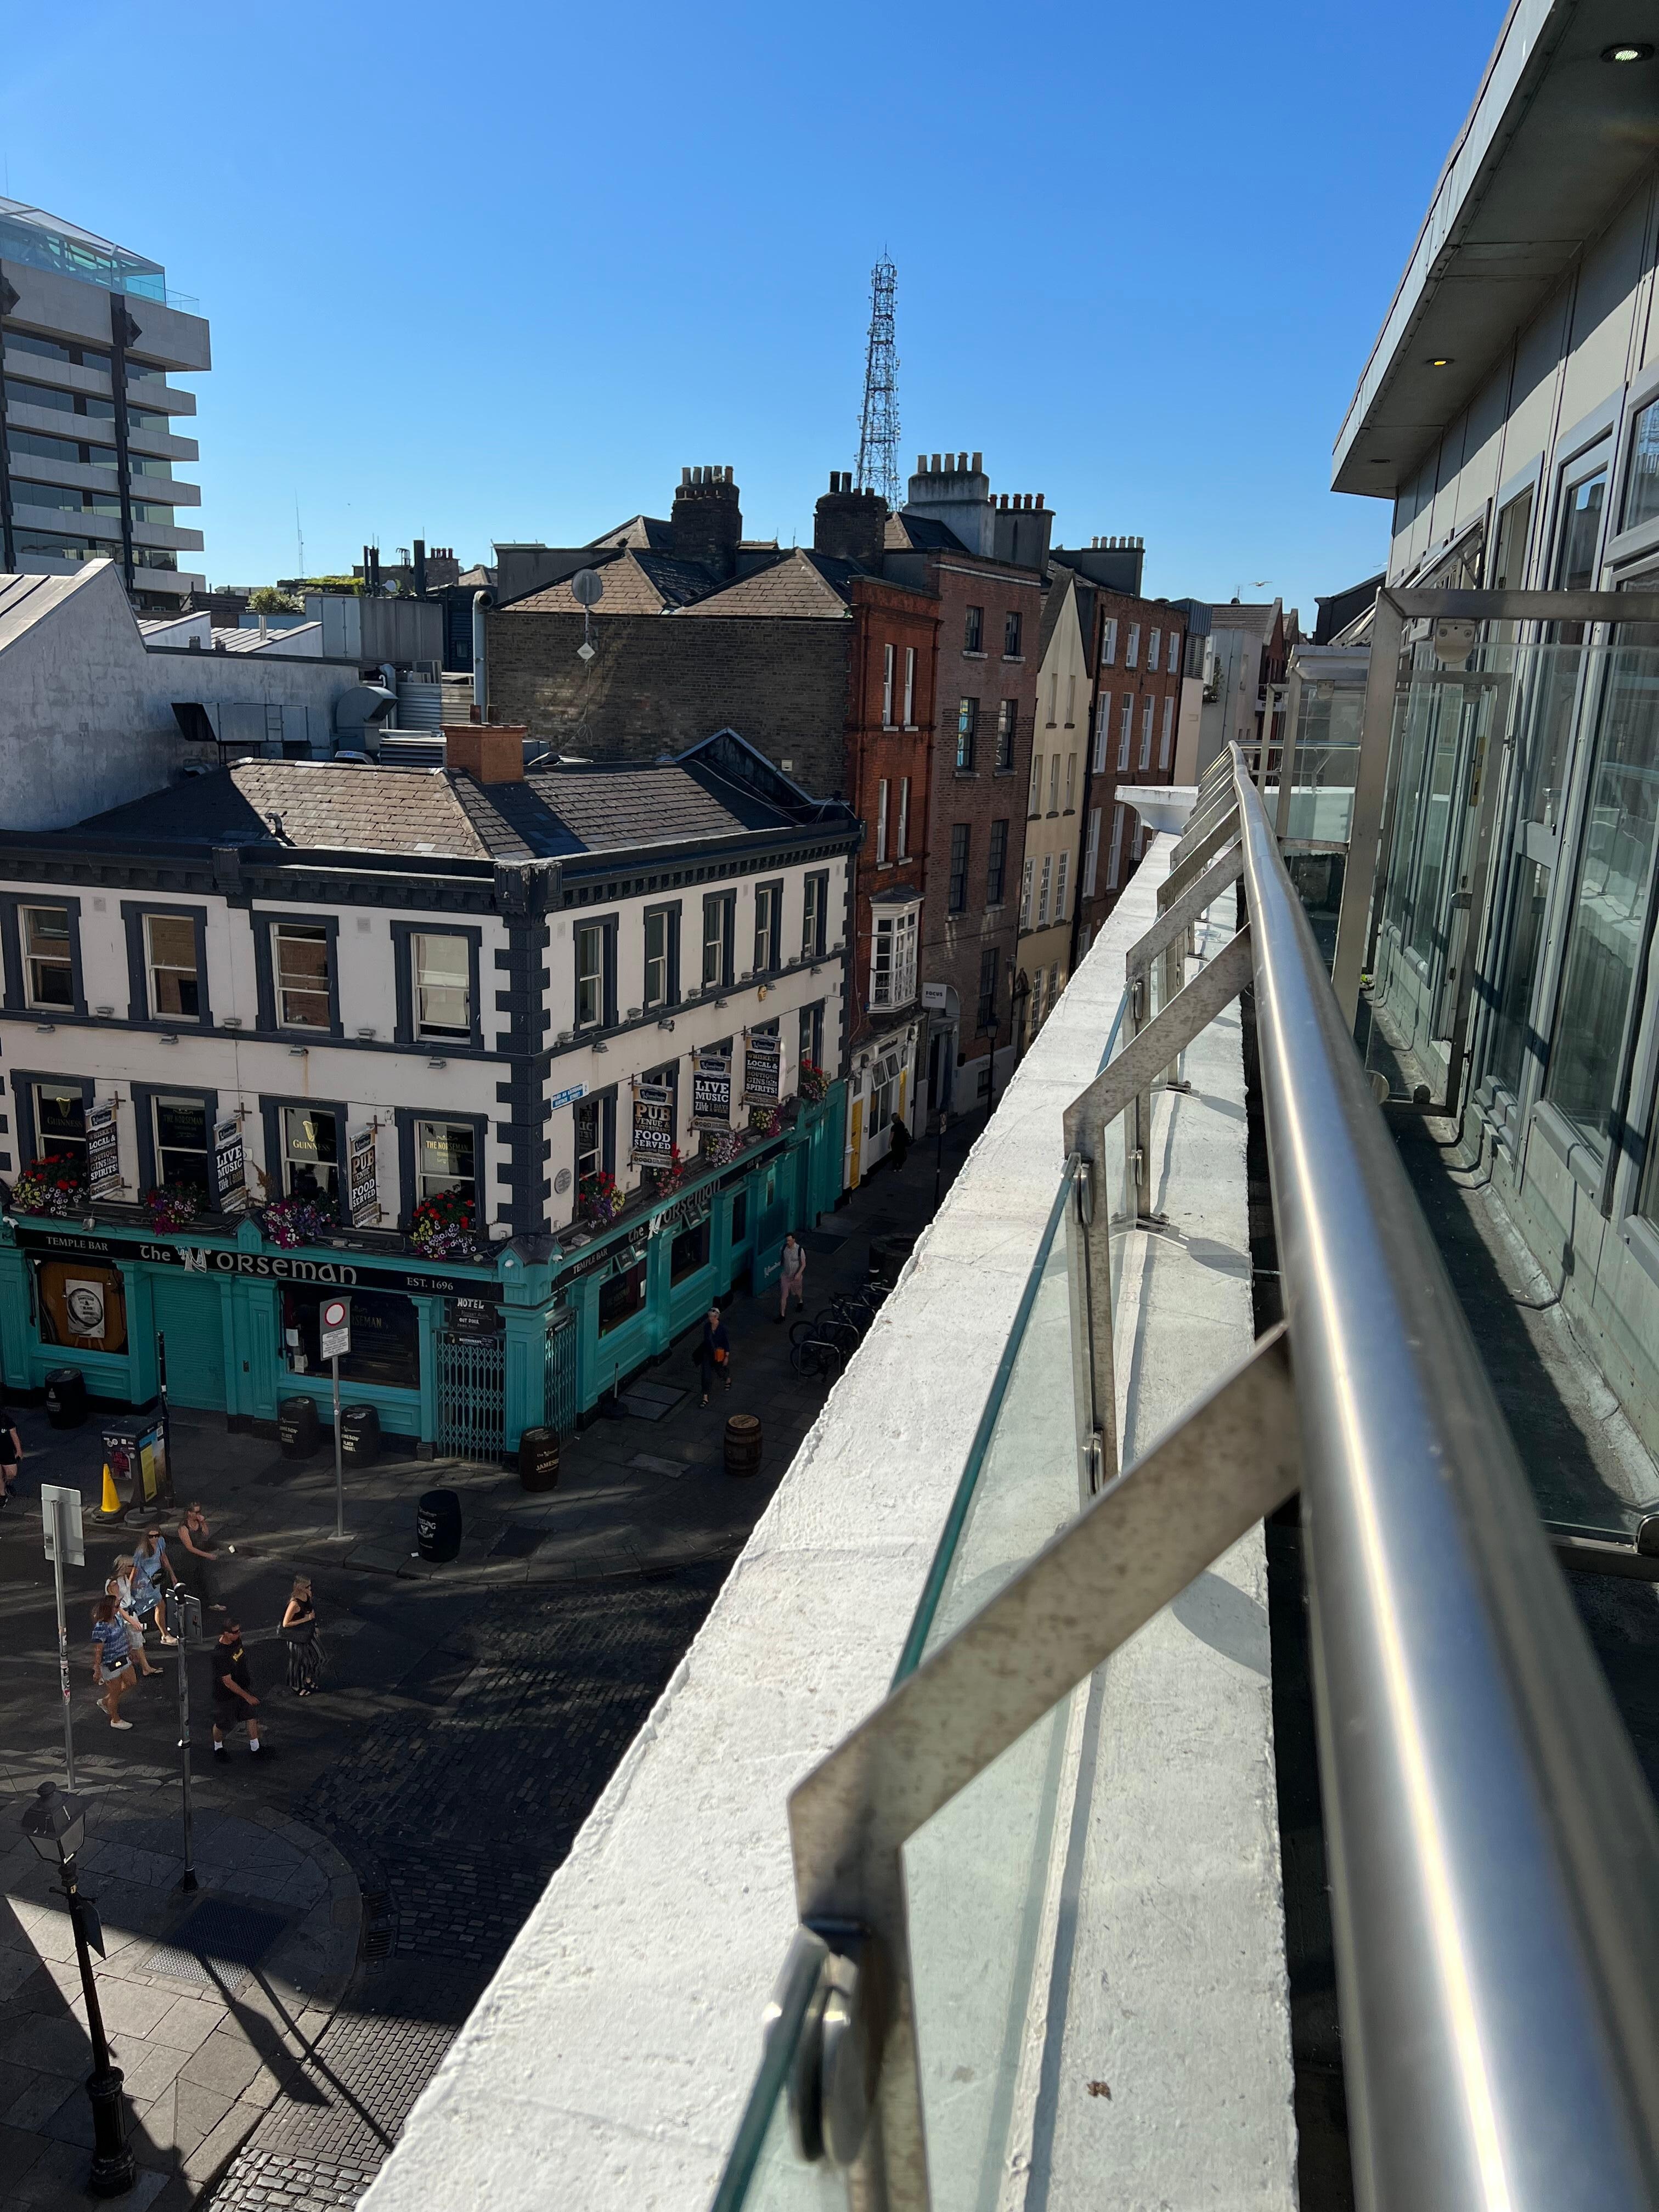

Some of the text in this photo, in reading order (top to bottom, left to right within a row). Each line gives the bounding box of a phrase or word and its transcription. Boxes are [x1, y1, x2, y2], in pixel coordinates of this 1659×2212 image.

[747, 1059, 771, 1069] LOCAL
[695, 1080, 729, 1094] LIVE
[746, 1084, 777, 1094] SPIRITS!
[695, 1092, 729, 1103] MUSIC
[635, 1103, 671, 1121] PUB
[47, 1116, 84, 1131] GUINNESS
[635, 1117, 663, 1127] VENUE
[89, 1134, 117, 1150] LOCAL &
[635, 1130, 671, 1143] FOOD
[293, 1139, 332, 1153] GUINNESS
[426, 1140, 469, 1152] THE NORSEMAN
[635, 1139, 671, 1150] SERVED
[217, 1145, 242, 1169] LIVE
[352, 1149, 375, 1175] PUB
[91, 1163, 119, 1181] SPIRITS!
[218, 1159, 243, 1180] MUSIC
[353, 1169, 370, 1183] VENUE
[353, 1178, 375, 1200] FOOD
[353, 1188, 376, 1208] SERVED
[47, 1236, 109, 1251] TEMPLE BAR
[140, 1245, 171, 1261] The
[573, 1248, 608, 1274] TEMPLE BAR
[407, 1277, 454, 1291] EST. 1696
